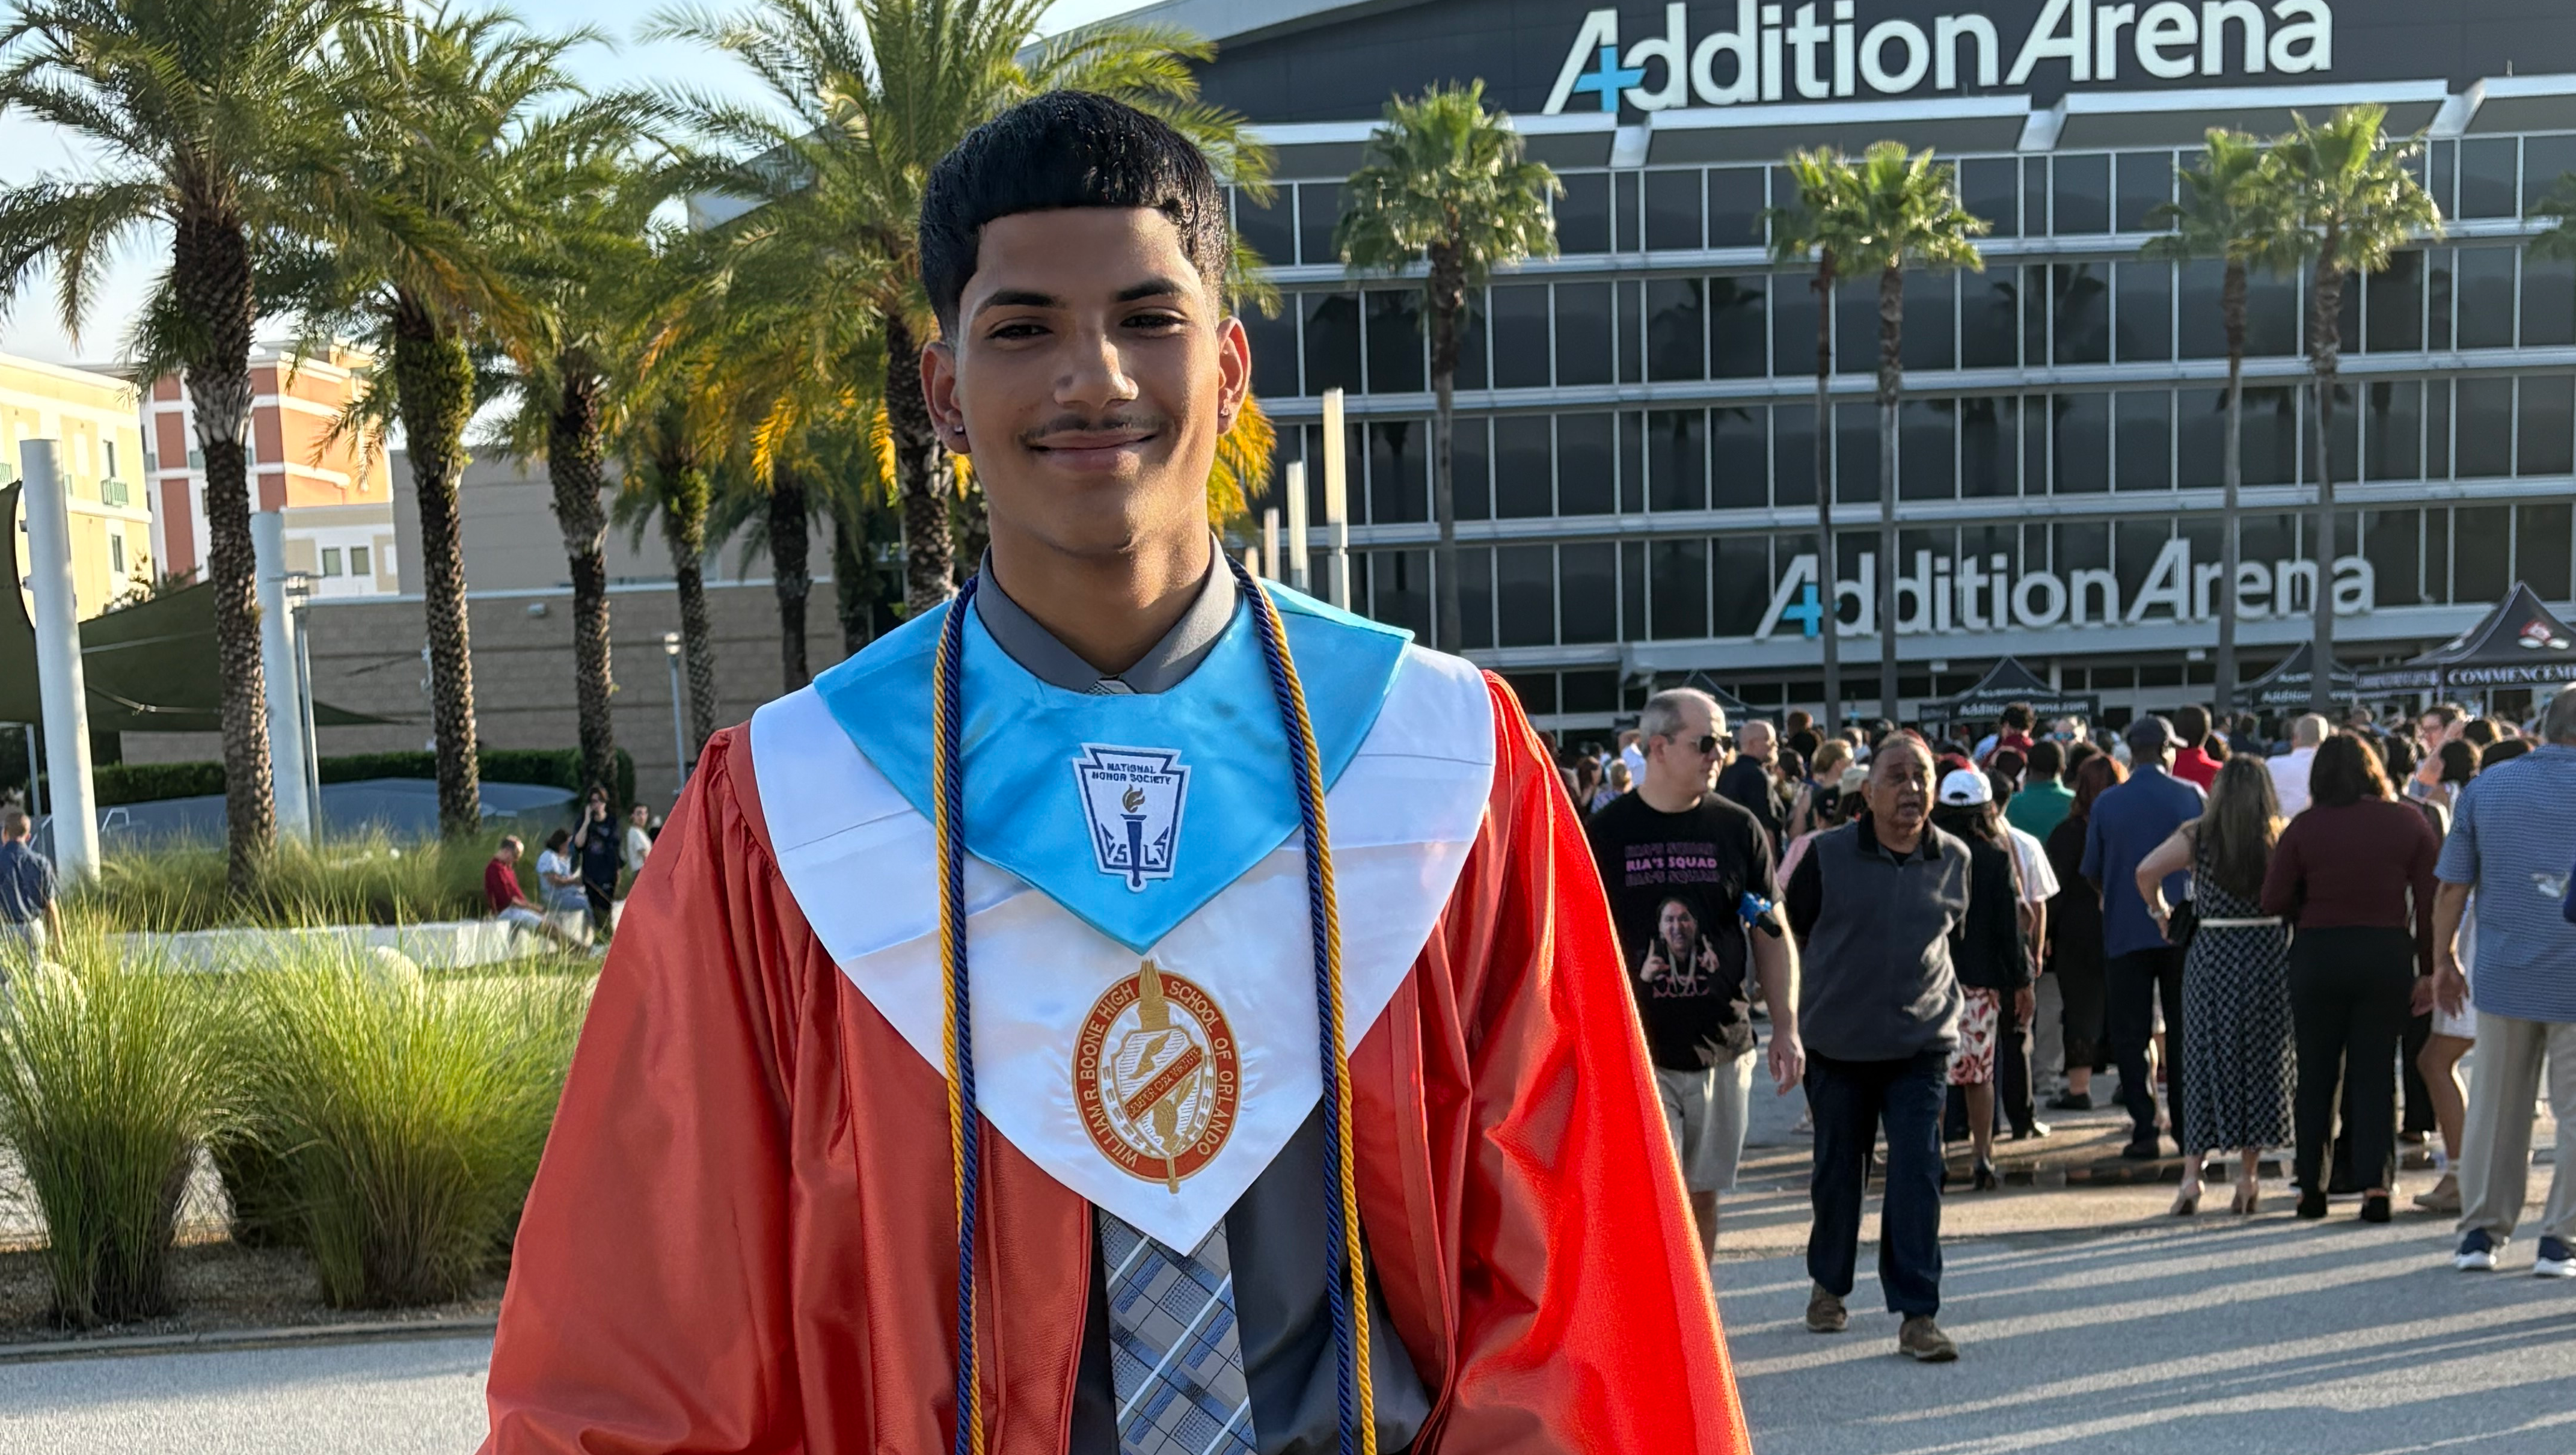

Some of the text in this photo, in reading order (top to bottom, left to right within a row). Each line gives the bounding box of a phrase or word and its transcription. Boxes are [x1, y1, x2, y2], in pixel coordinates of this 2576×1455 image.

[1542, 0, 2332, 114] Addition Arena
[1755, 538, 2375, 640] Addition Arena
[2447, 664, 2576, 685] COMMENCEM
[1091, 771, 1172, 785] HONOR SOCIETY
[1106, 762, 1156, 774] NATIONAL
[1668, 856, 1718, 869] SQUAD
[1098, 982, 1136, 1020] HIGH
[1168, 980, 1219, 1034] SCHOOL
[1080, 1020, 1106, 1080] BOONE
[1213, 1037, 1232, 1060] OF
[1086, 1103, 1139, 1168] WILLIAM
[1197, 1070, 1234, 1156] ORLANDO
